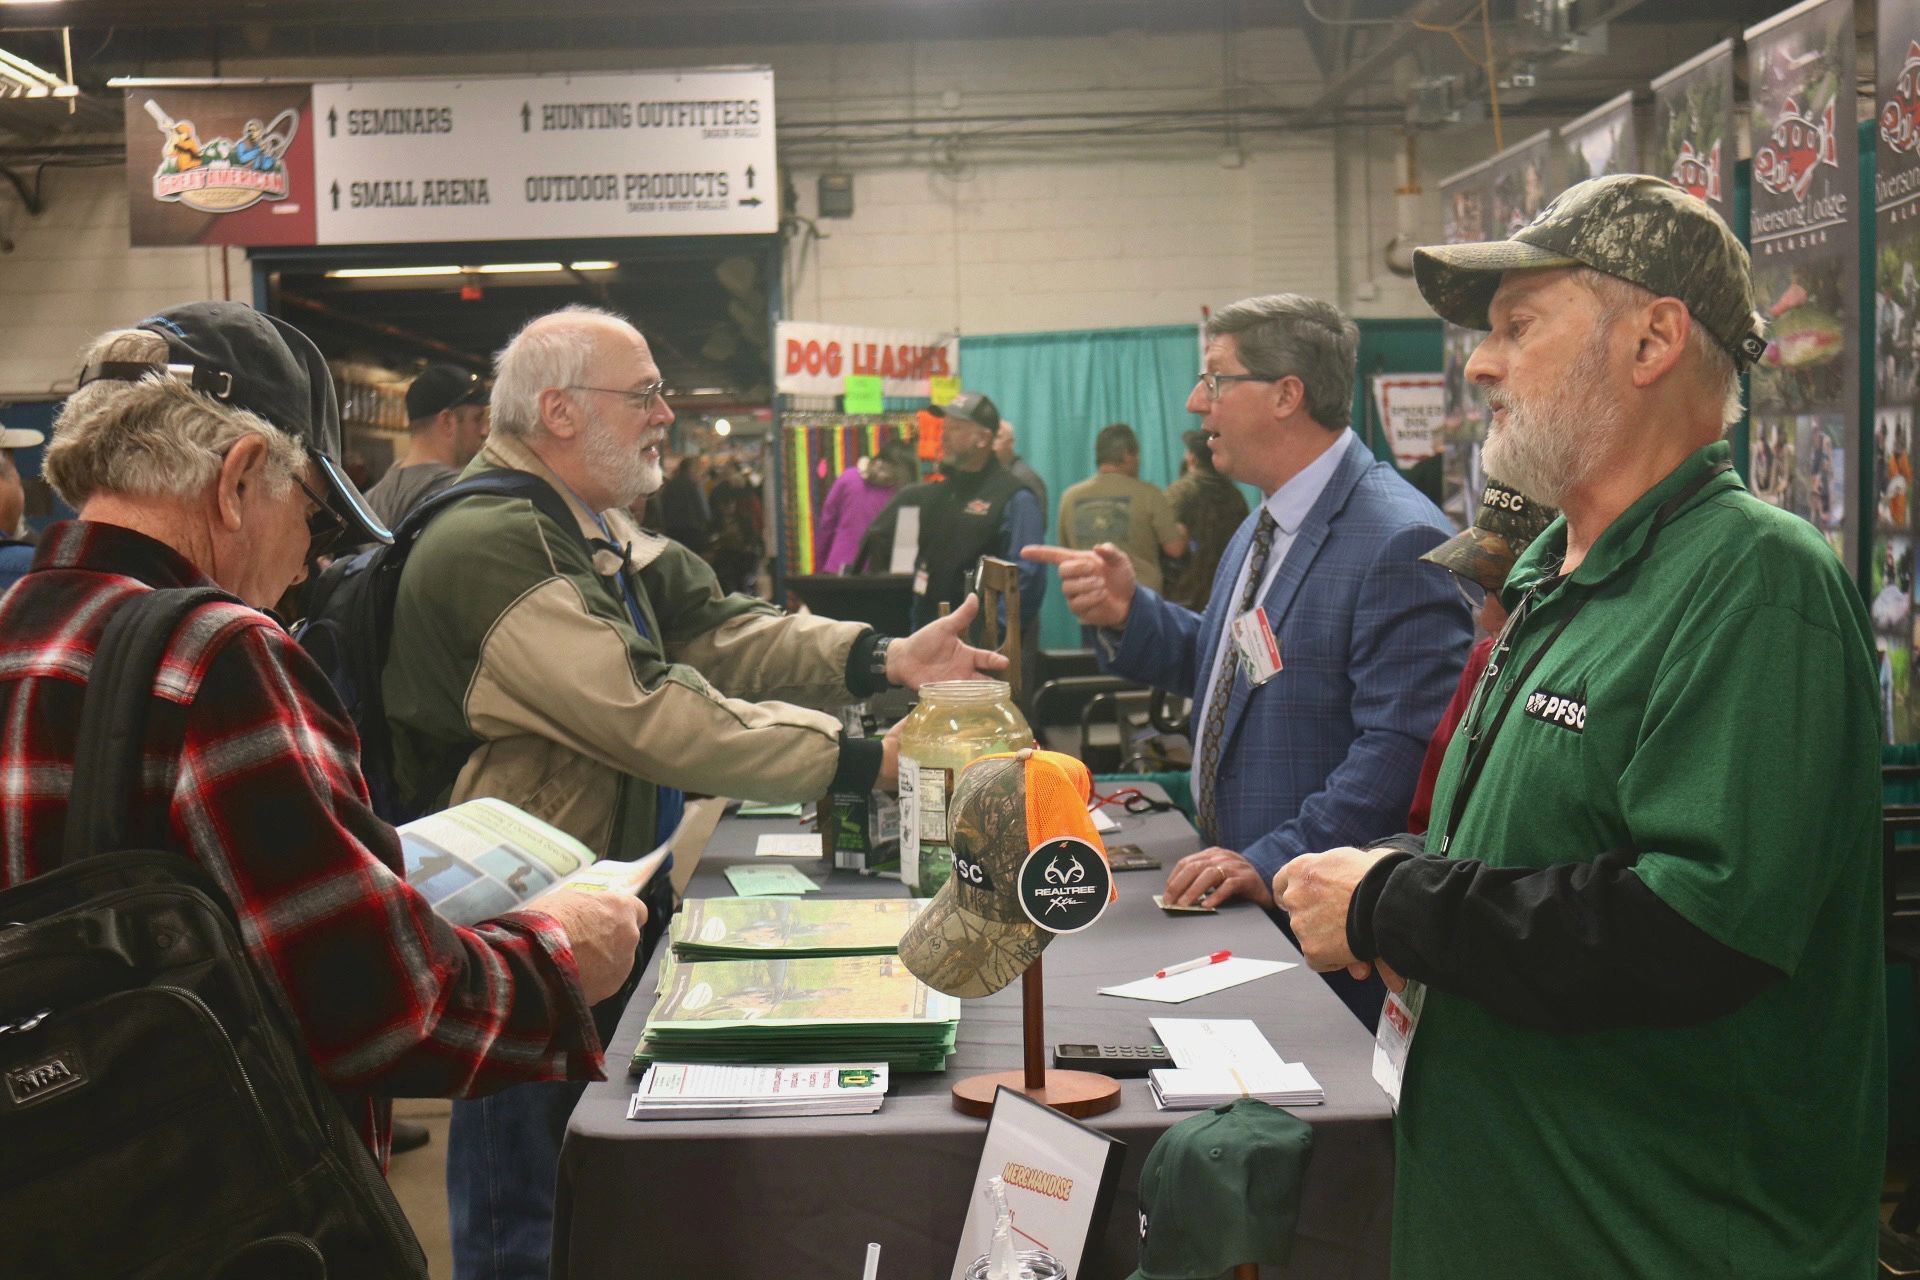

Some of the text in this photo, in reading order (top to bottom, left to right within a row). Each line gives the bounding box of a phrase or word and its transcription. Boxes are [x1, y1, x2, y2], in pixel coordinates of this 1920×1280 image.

[347, 107, 453, 135] SEMINARS
[542, 99, 761, 131] HUNTING OUTFITTERS
[350, 178, 490, 208] SMALL ARENA
[526, 172, 729, 202] OUTDOOR PRODUCTS
[1807, 179, 1847, 224] Lodge
[1765, 231, 1827, 255] ALASKA
[786, 339, 950, 379] DOG LEASHES
[1542, 696, 1586, 729] PFSC
[1034, 885, 1096, 897] REALTREE
[1002, 1161, 1074, 1202] MERCHANDISE
